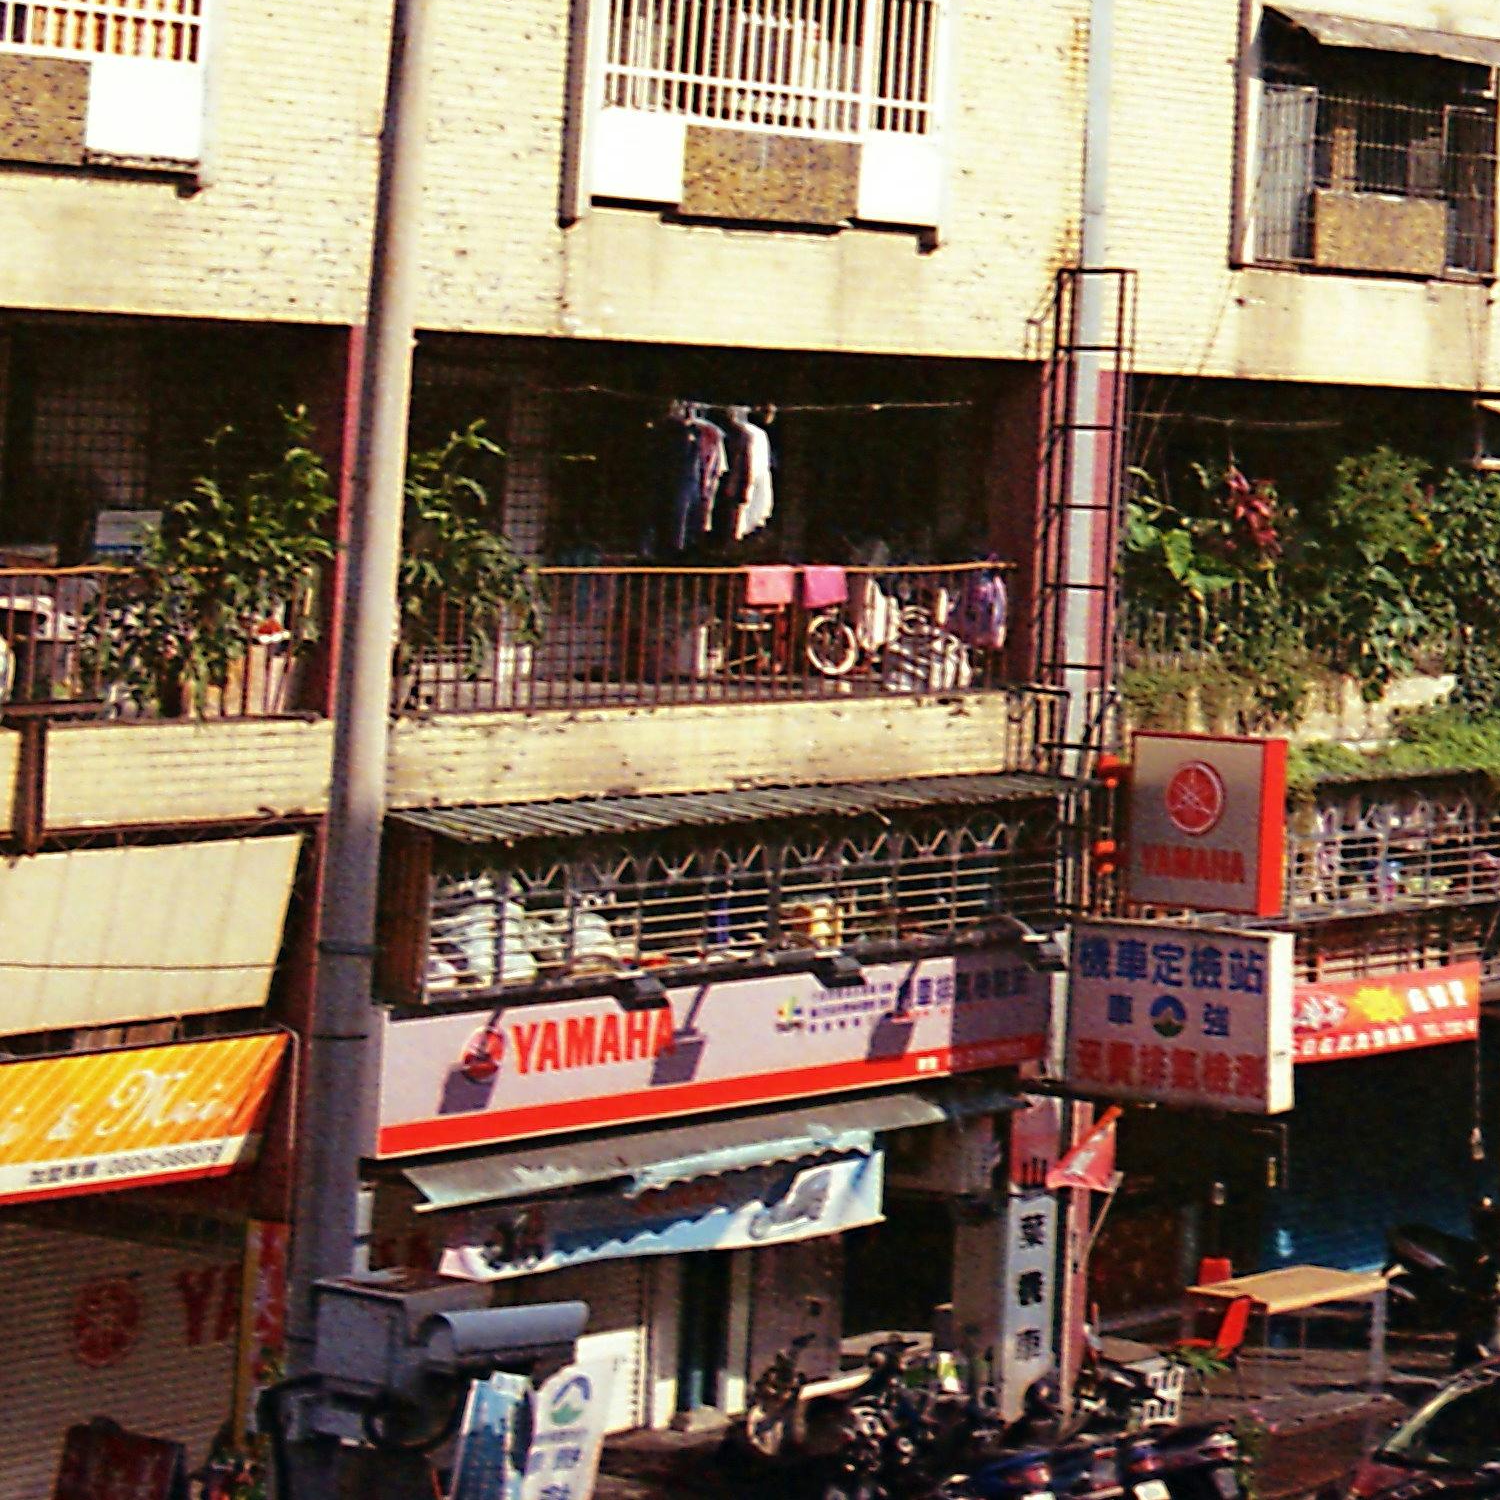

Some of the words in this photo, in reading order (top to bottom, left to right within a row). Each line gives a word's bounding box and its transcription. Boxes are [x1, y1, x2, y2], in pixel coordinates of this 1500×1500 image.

[1141, 844, 1246, 885] YAMAHA
[1079, 937, 1264, 995] 機車定檢站
[510, 1006, 675, 1076] YAMAHA
